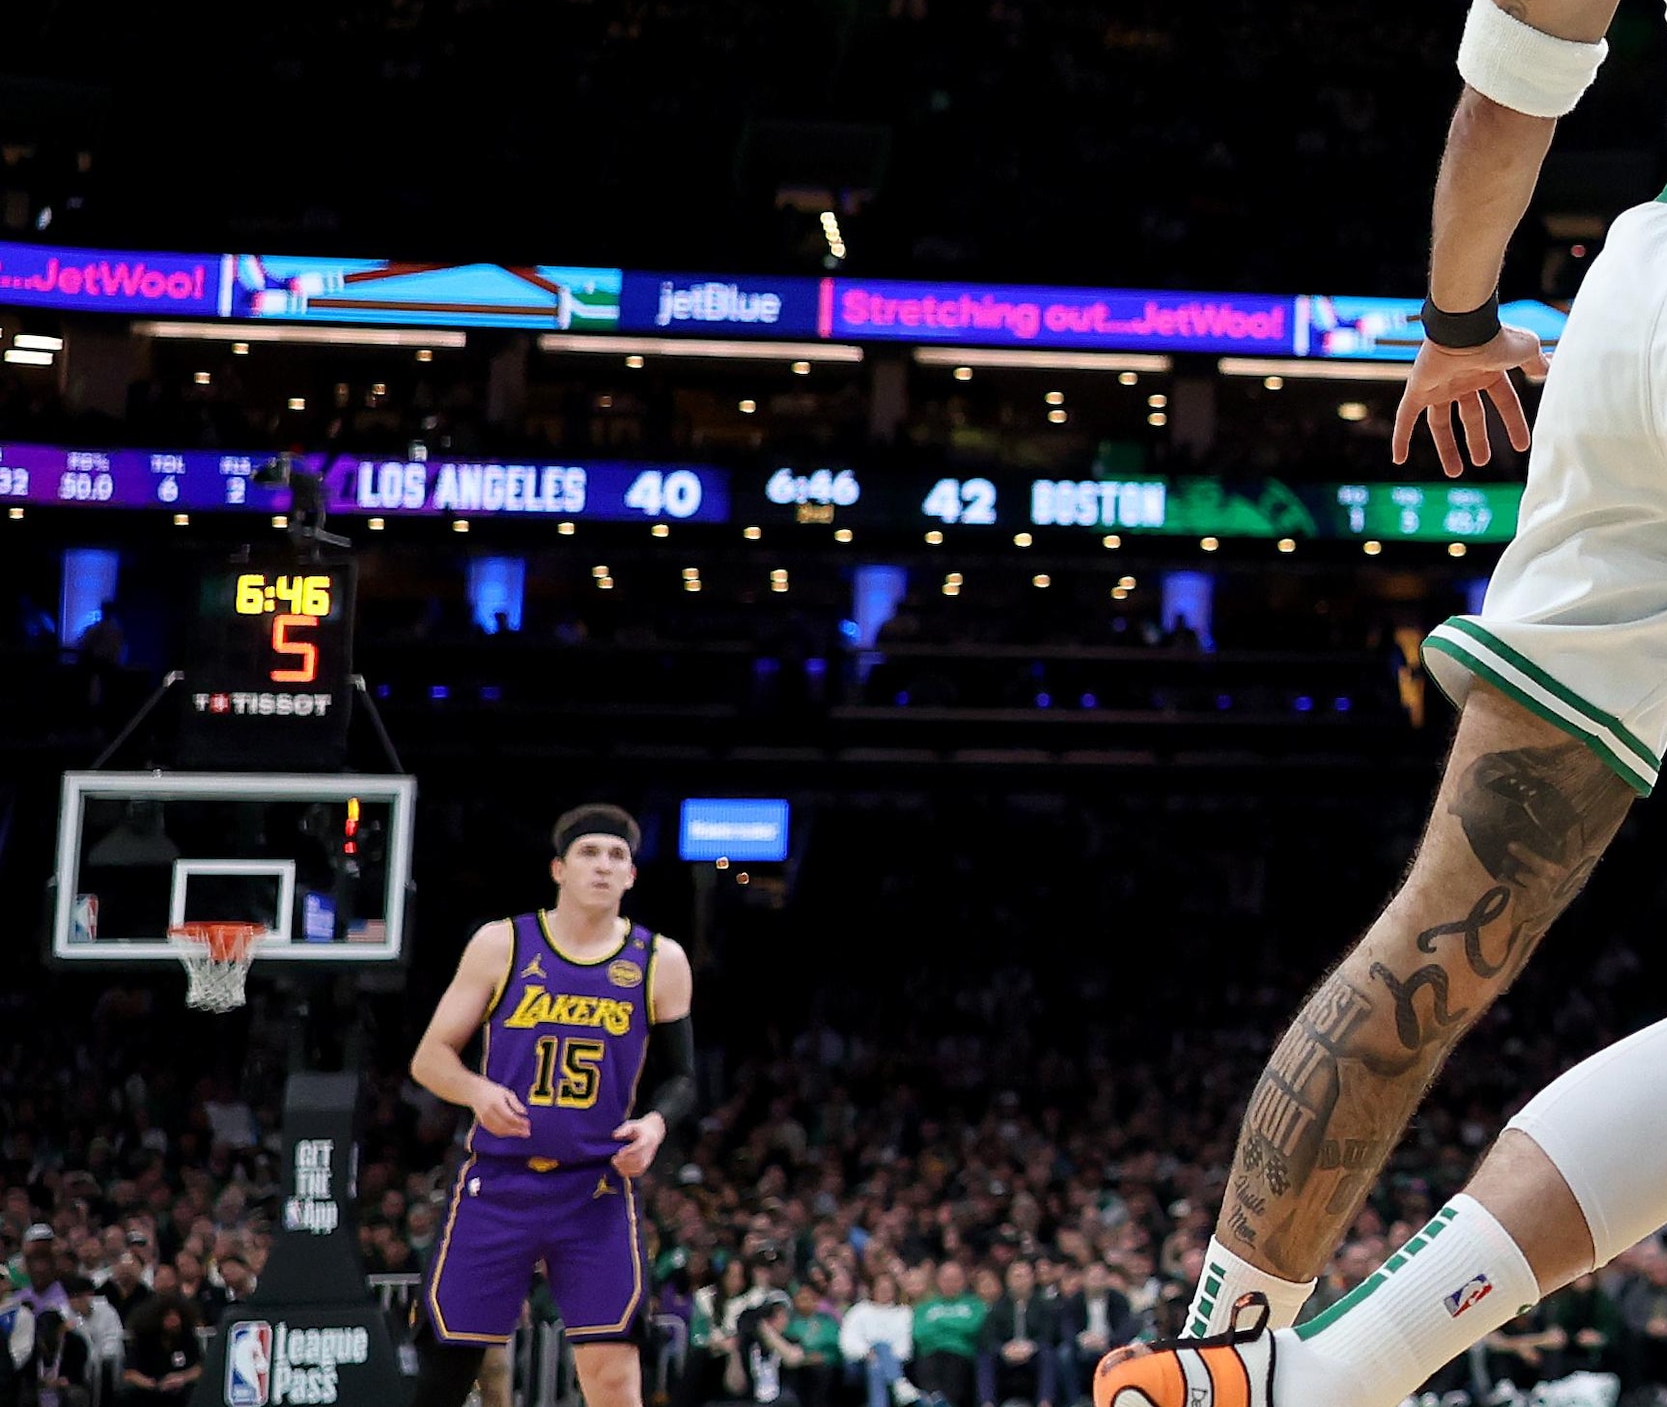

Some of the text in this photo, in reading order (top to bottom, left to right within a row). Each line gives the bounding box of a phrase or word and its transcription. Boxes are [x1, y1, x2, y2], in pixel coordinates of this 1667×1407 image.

[656, 281, 782, 326] jetBlue
[842, 287, 1038, 339] Stretching
[357, 461, 702, 518] LOS ANGELES 40
[765, 467, 860, 506] 6:46
[921, 477, 1167, 528] 42 BOSTON
[236, 574, 331, 616] 6:46
[270, 614, 320, 682] 5
[231, 692, 332, 717] TISSOT
[503, 983, 634, 1037] LAKERS
[528, 1034, 607, 1110] 15
[274, 1321, 369, 1373] League
